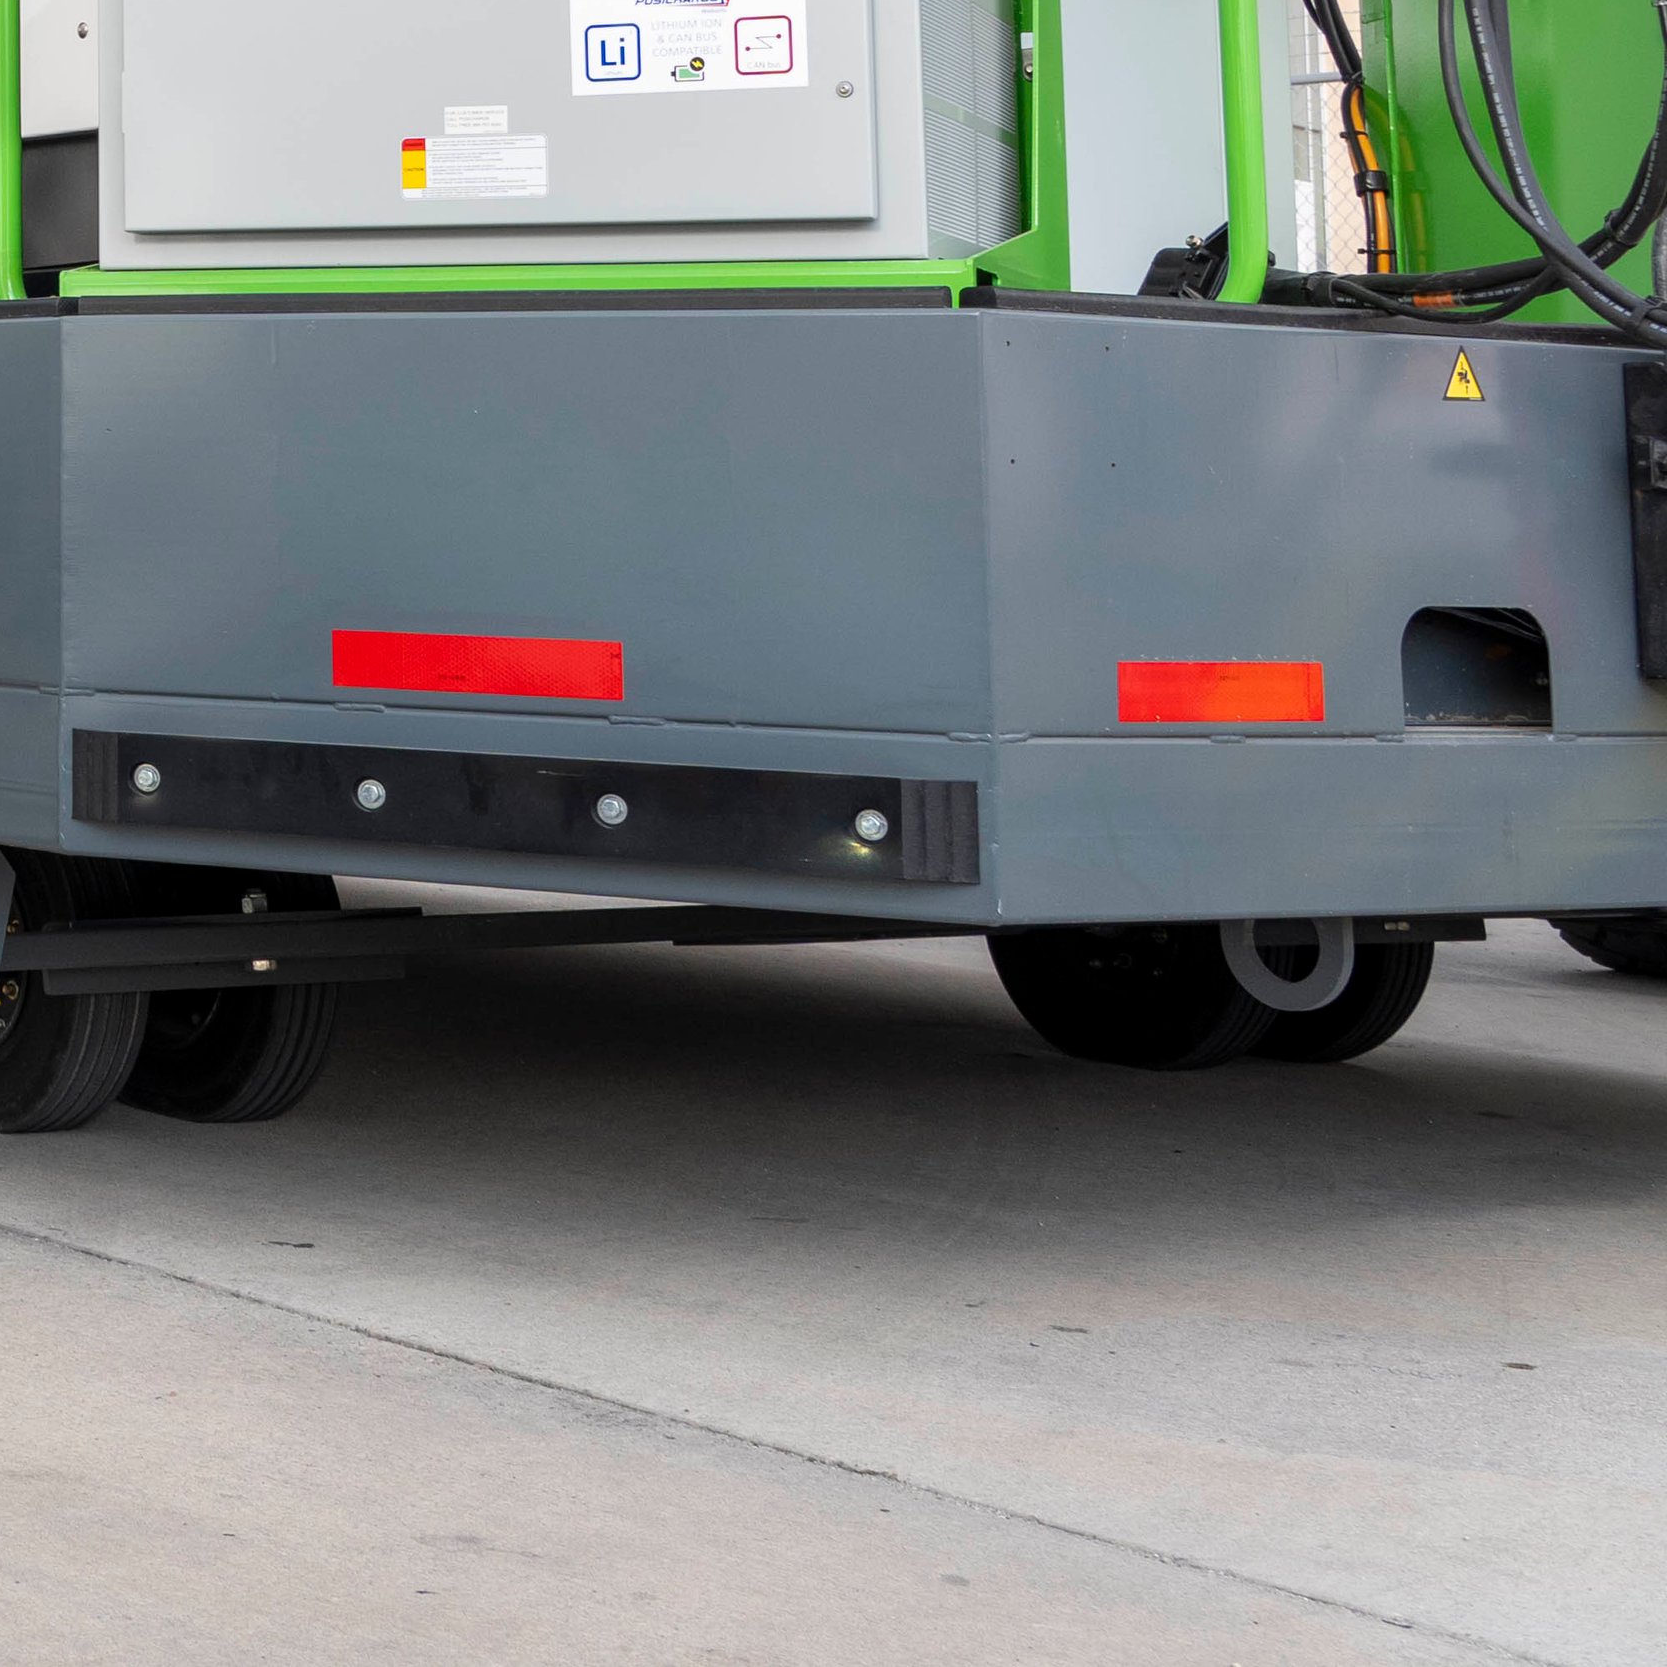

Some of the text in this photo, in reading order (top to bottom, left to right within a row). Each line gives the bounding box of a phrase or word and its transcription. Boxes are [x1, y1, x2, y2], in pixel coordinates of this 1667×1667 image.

[651, 18, 723, 31] LITHIUM ION
[668, 33, 693, 43] CAN
[697, 31, 718, 42] BUS
[600, 37, 625, 66] Li
[652, 45, 723, 57] COMPATIBLE
